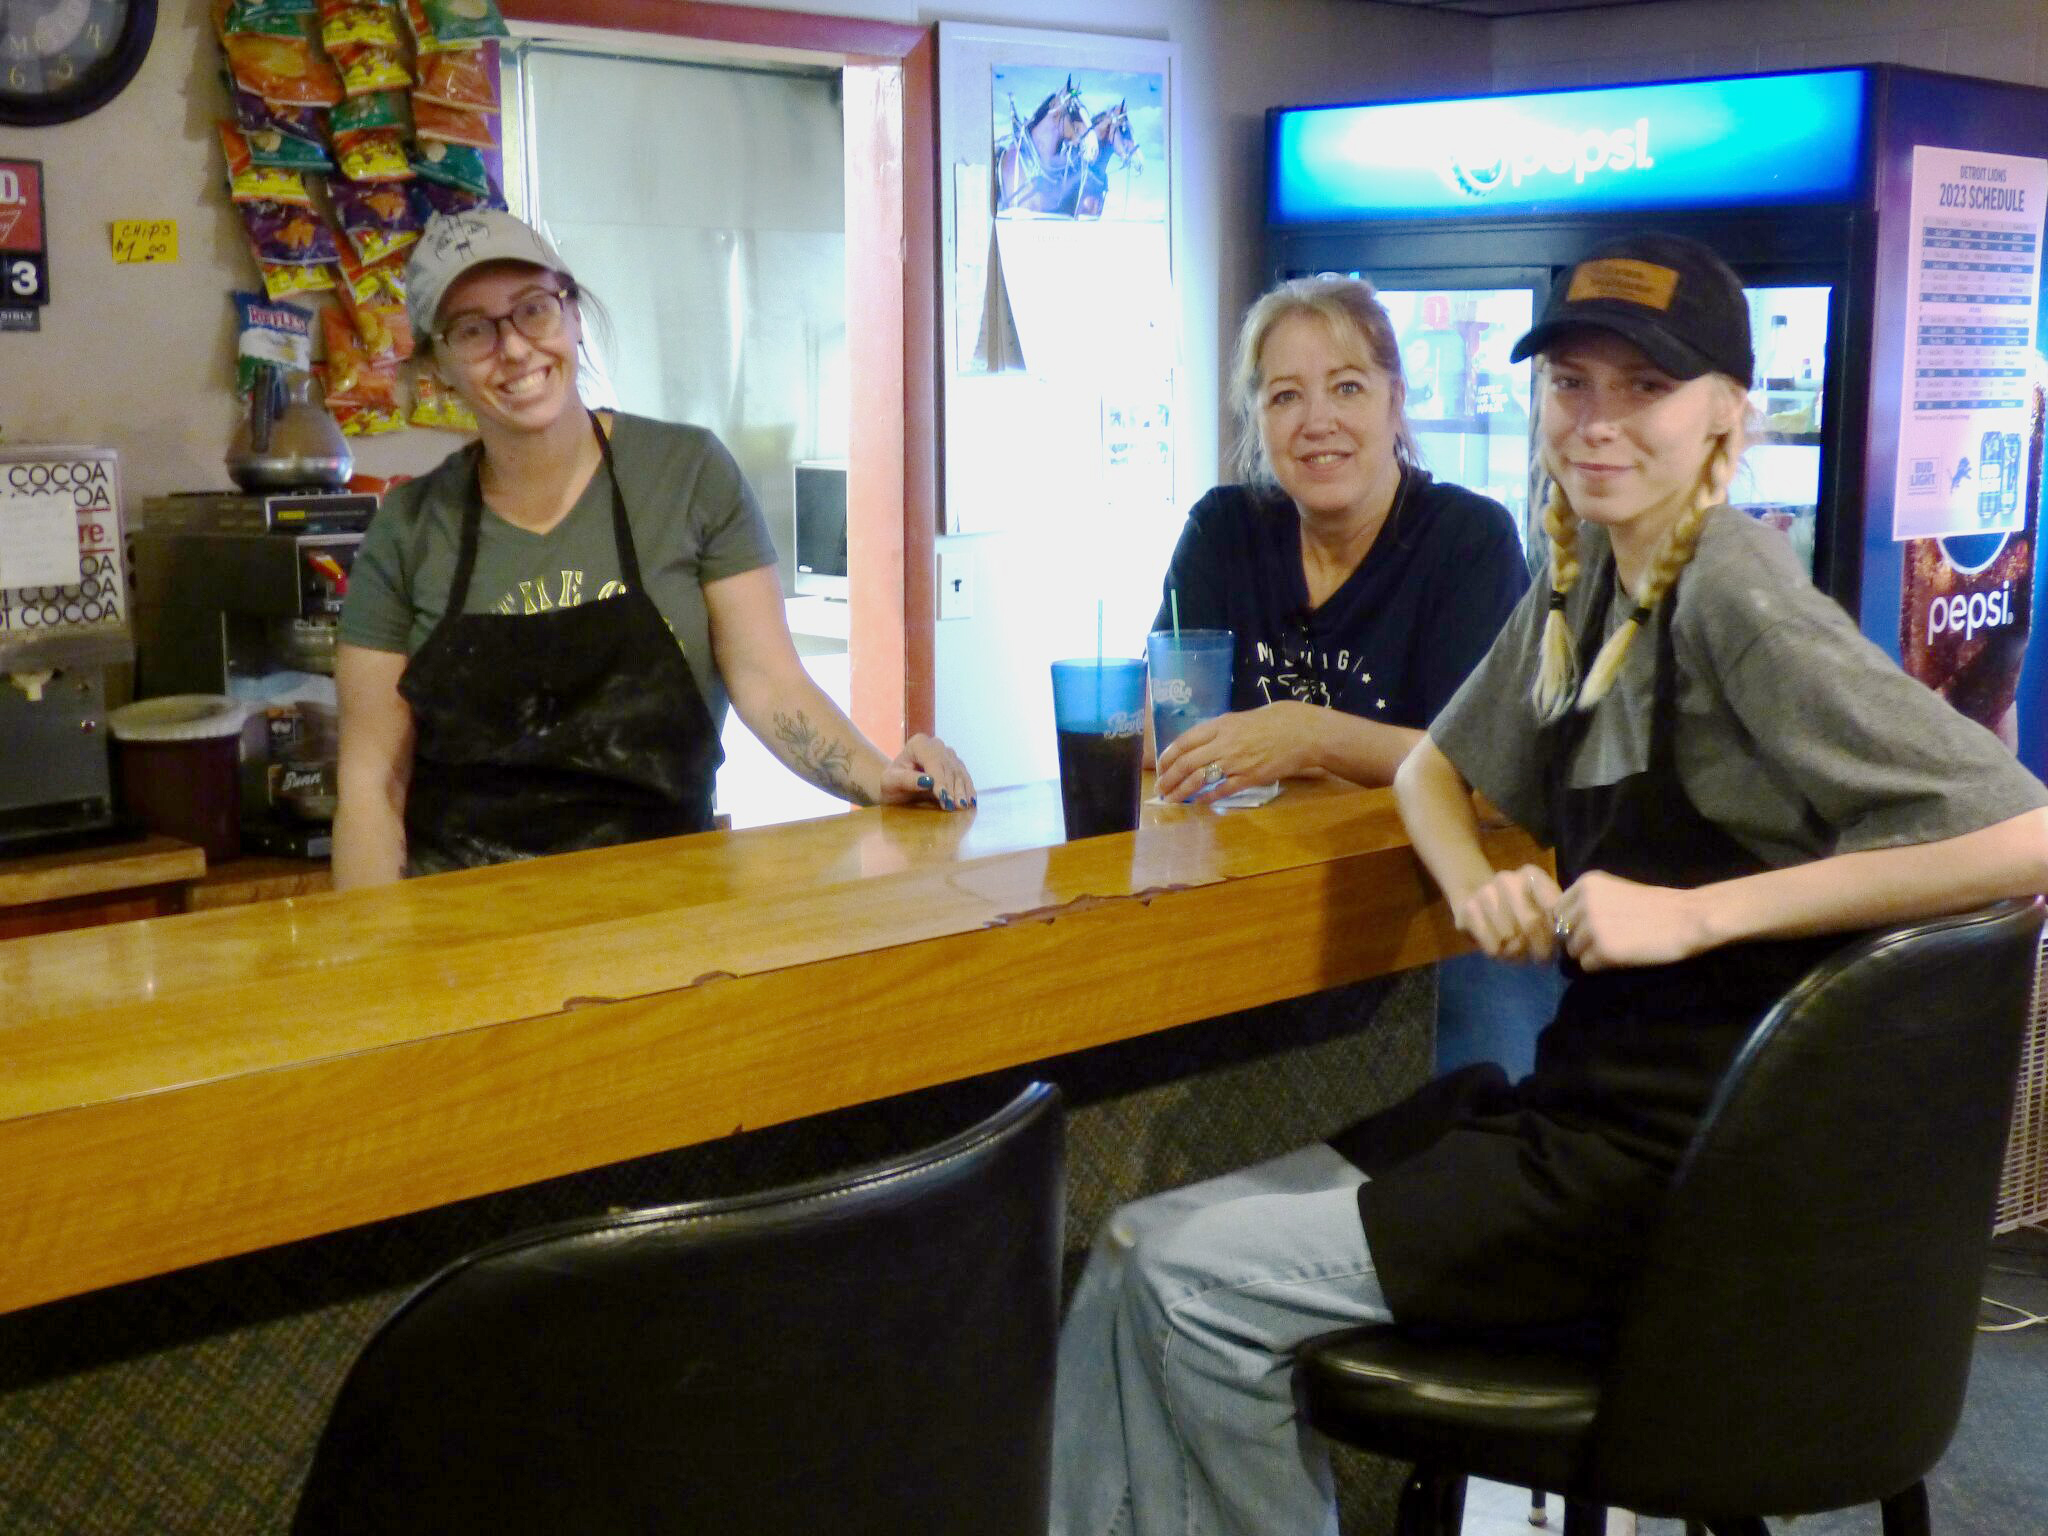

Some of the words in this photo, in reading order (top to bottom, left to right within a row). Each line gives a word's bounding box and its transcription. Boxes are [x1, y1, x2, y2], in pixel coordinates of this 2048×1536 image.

[1959, 165, 1987, 181] DETROIT
[1987, 167, 2008, 184] LIONS
[1939, 182, 1967, 209] 2023
[1968, 184, 2026, 213] SCHEDULE
[121, 222, 172, 242] CHIPS
[11, 260, 39, 296] 3
[8, 462, 108, 489] COCOA
[1909, 473, 1936, 488] LIGHT
[1914, 461, 1934, 474] BUD
[20, 598, 120, 628] COCOA
[1927, 579, 2010, 646] pepsi
